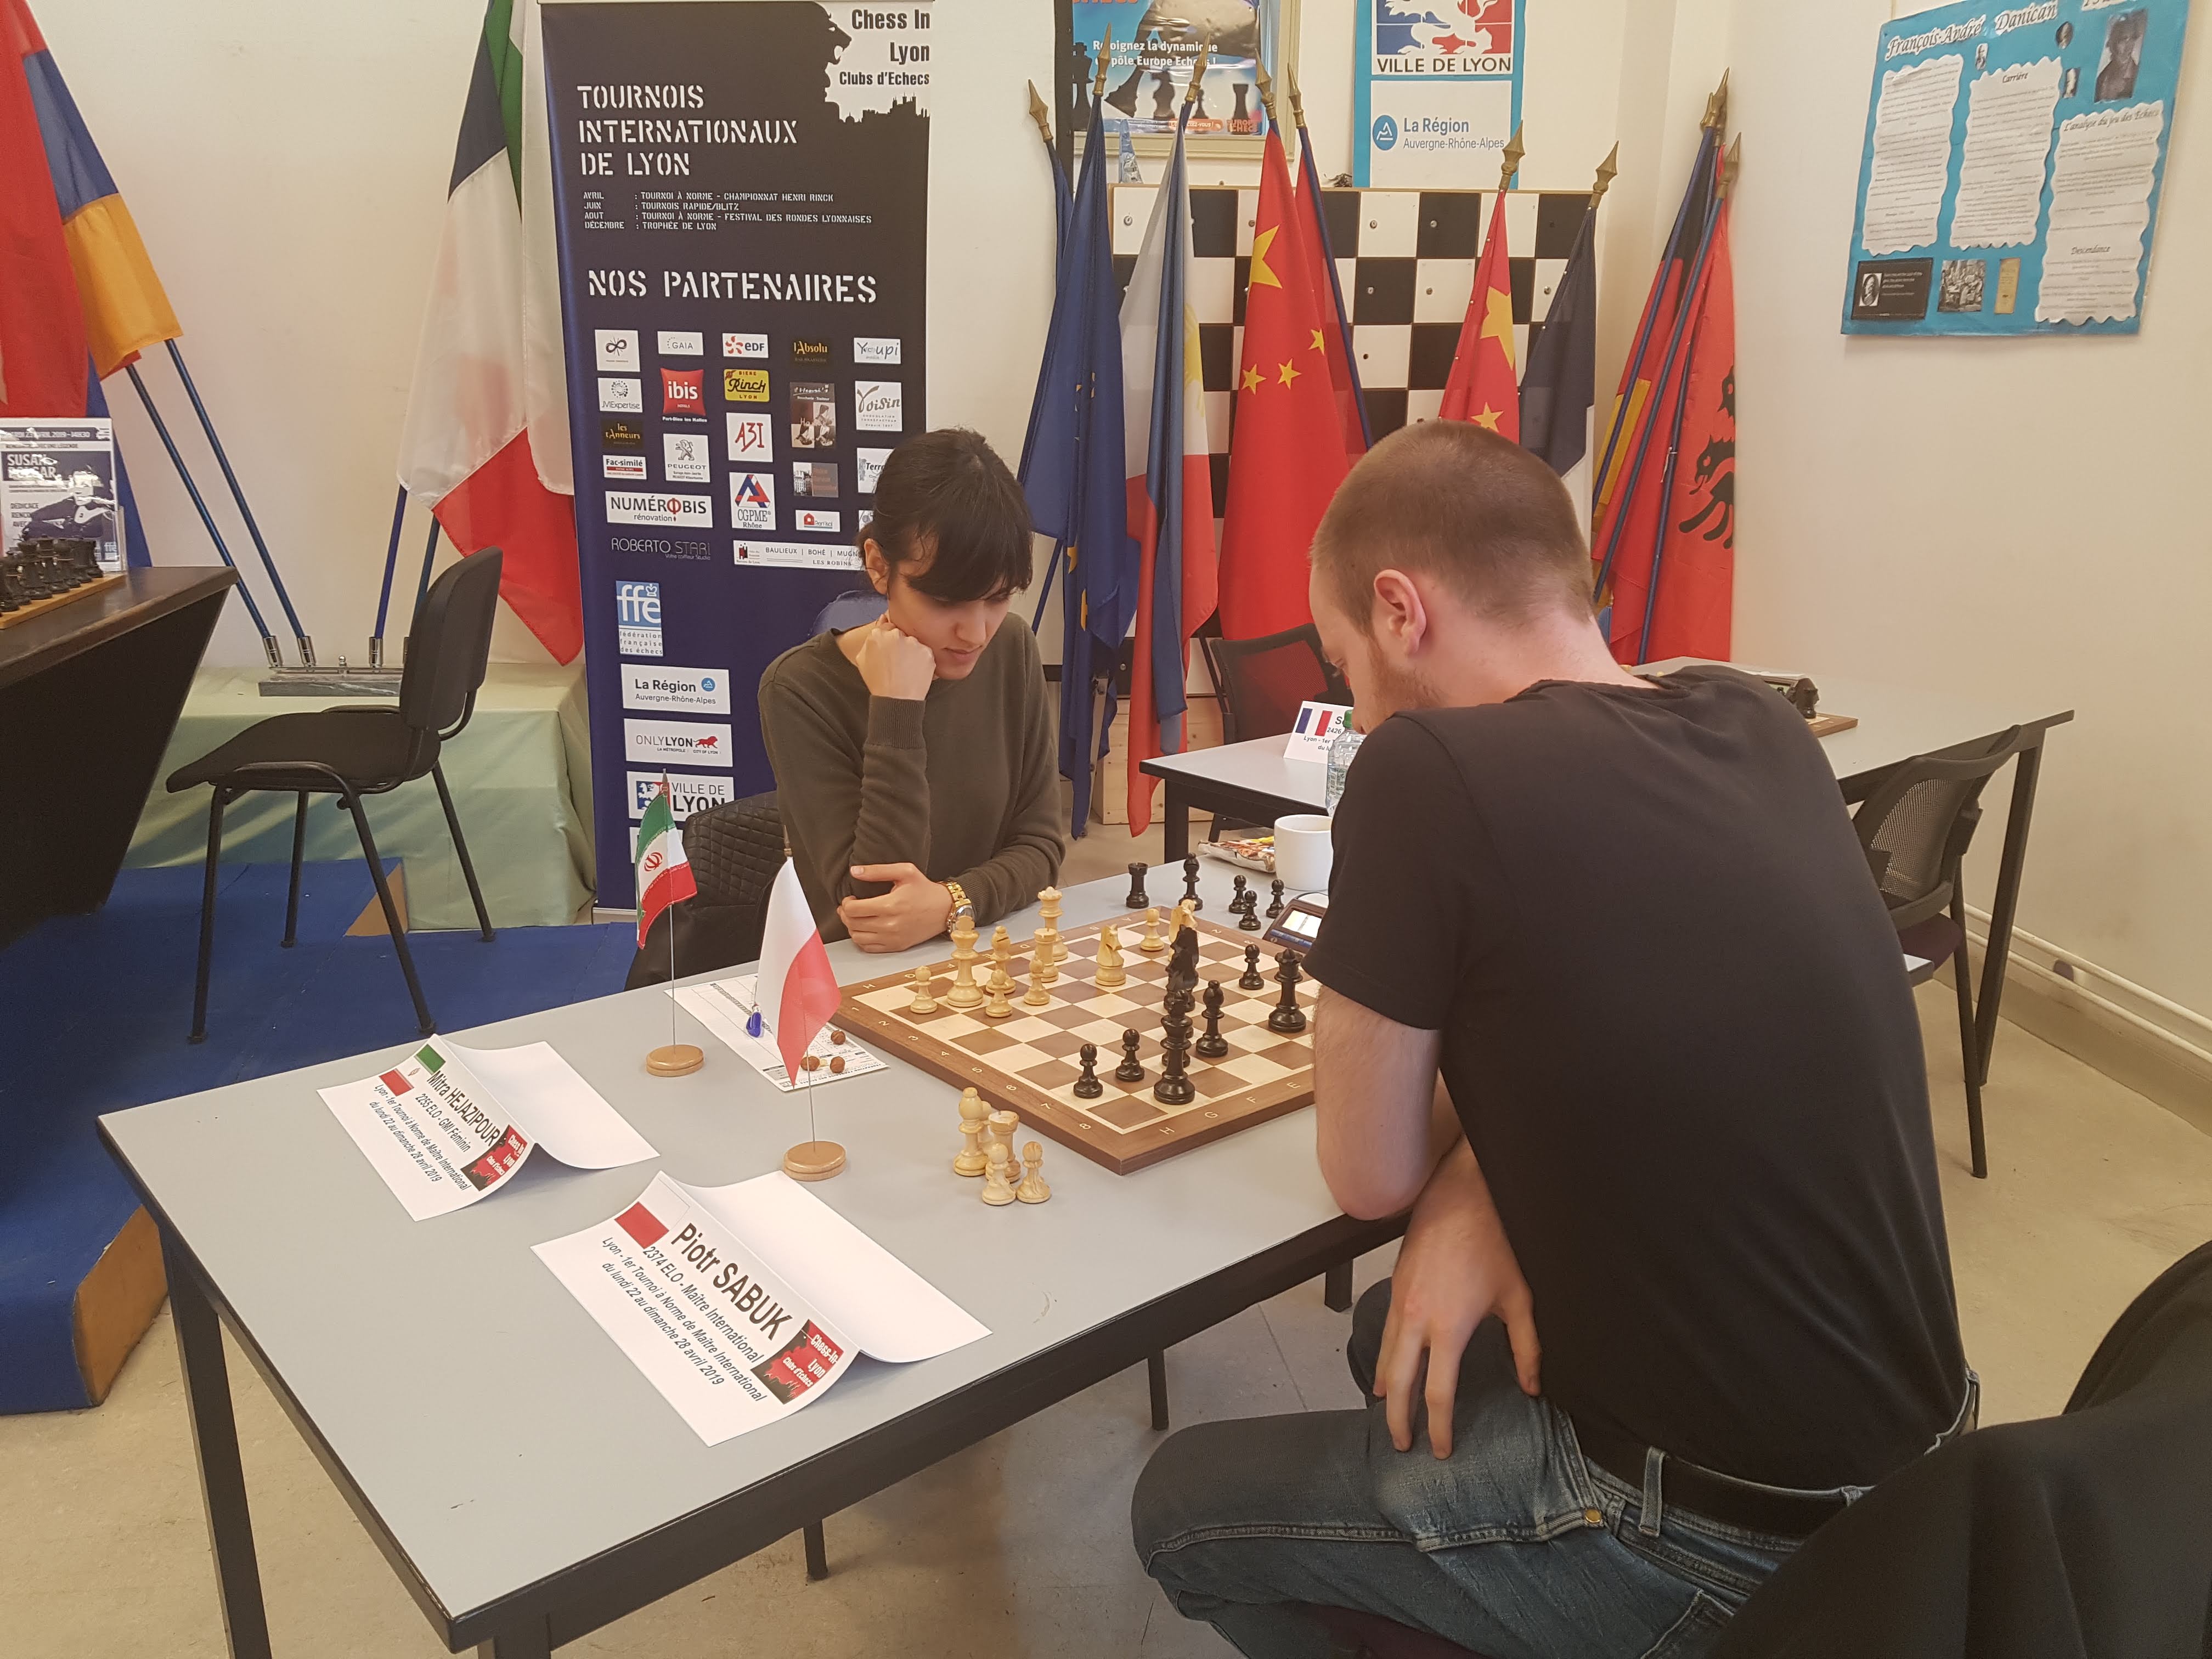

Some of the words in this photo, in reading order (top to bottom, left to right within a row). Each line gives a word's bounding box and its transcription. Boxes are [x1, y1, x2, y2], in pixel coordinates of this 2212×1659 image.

[852, 9, 907, 29] Chess
[915, 9, 930, 29] In
[1995, 4, 2058, 31] Danican
[890, 42, 929, 65] Lyon
[1148, 41, 1158, 50] la
[1111, 55, 1134, 67] pôle
[1137, 56, 1172, 69] Europe
[1377, 58, 1425, 72] VILLE
[1433, 58, 1455, 72] DE
[1463, 57, 1511, 72] LYON
[839, 71, 873, 85] Clubs
[878, 72, 929, 85] d'Echecs
[2002, 71, 2029, 84] Carrière
[577, 85, 704, 109] TOURNOIS
[579, 120, 797, 144] INTERNATIONAUX
[1404, 118, 1418, 132] La
[1423, 117, 1469, 136] Région
[1403, 137, 1505, 151] Auvergne-Rhône-Alpes
[581, 153, 613, 175] DE
[627, 153, 690, 175] LYON
[724, 193, 778, 201] CHAMPIONNAT
[683, 202, 739, 211] RAPIDE/BLITZ
[585, 221, 624, 229] DÉCEMBRE
[642, 221, 679, 229] TROPHÉE
[642, 212, 675, 220] TOURNOI
[725, 213, 762, 221] FESTIVAL
[766, 213, 782, 222] DES
[786, 214, 818, 222] RONDES
[822, 215, 872, 223] LYONNAISES
[588, 270, 647, 297] NOS
[664, 271, 877, 303] PARTENAIRES
[668, 381, 698, 399] ibis
[857, 385, 900, 413] Voisin
[606, 458, 642, 467] Fac-similé
[634, 514, 672, 522] rénovation
[611, 538, 671, 553] ROBERTO
[617, 584, 662, 623] ffe
[635, 679, 649, 690] La
[653, 680, 697, 694] Région
[635, 693, 716, 704] Auvergne-Rhône-Alpes
[672, 782, 704, 794] VILLE
[709, 785, 725, 795] DE
[369, 1101, 380, 1110] du
[376, 1107, 390, 1120] lundi
[427, 1070, 451, 1097] Mitra
[444, 1087, 500, 1147] HEJAZIPOUR
[415, 1093, 430, 1108] 2255
[428, 1104, 442, 1119] ELO
[439, 1118, 455, 1132] GMI
[448, 1128, 471, 1153] Féminin
[1159, 1126, 1175, 1135] H
[374, 1084, 388, 1097] Lyon
[392, 1103, 412, 1122] Tournoi
[411, 1123, 426, 1139] Norme
[426, 1144, 443, 1161] Maître
[438, 1158, 472, 1191] International
[393, 1129, 416, 1153] dimanche
[411, 1151, 424, 1160] 28
[415, 1156, 433, 1171] avril
[424, 1167, 443, 1182] 2019
[602, 1237, 622, 1257] Lyon
[622, 1256, 636, 1268] 1er
[632, 1266, 663, 1294] Tournoi
[671, 1223, 721, 1273] Piotr
[713, 1263, 793, 1341] SABUK
[655, 1290, 667, 1299] à
[642, 1246, 668, 1266] 2374
[660, 1263, 684, 1283] ELO
[681, 1284, 710, 1312] Maître
[706, 1308, 764, 1363] International
[660, 1296, 687, 1321] Norme
[602, 1262, 616, 1273] du
[610, 1271, 631, 1290] lundi
[626, 1287, 642, 1299] 22
[634, 1296, 647, 1307] au
[644, 1305, 679, 1340] dimanche
[674, 1338, 691, 1350] 28
[684, 1348, 708, 1367] avril
[699, 1365, 725, 1385] 2019
[682, 1320, 696, 1331] de
[692, 1329, 718, 1353] Maître
[810, 1334, 831, 1358] Chess
[714, 1352, 768, 1402] International
[808, 1359, 826, 1379] Lyon
